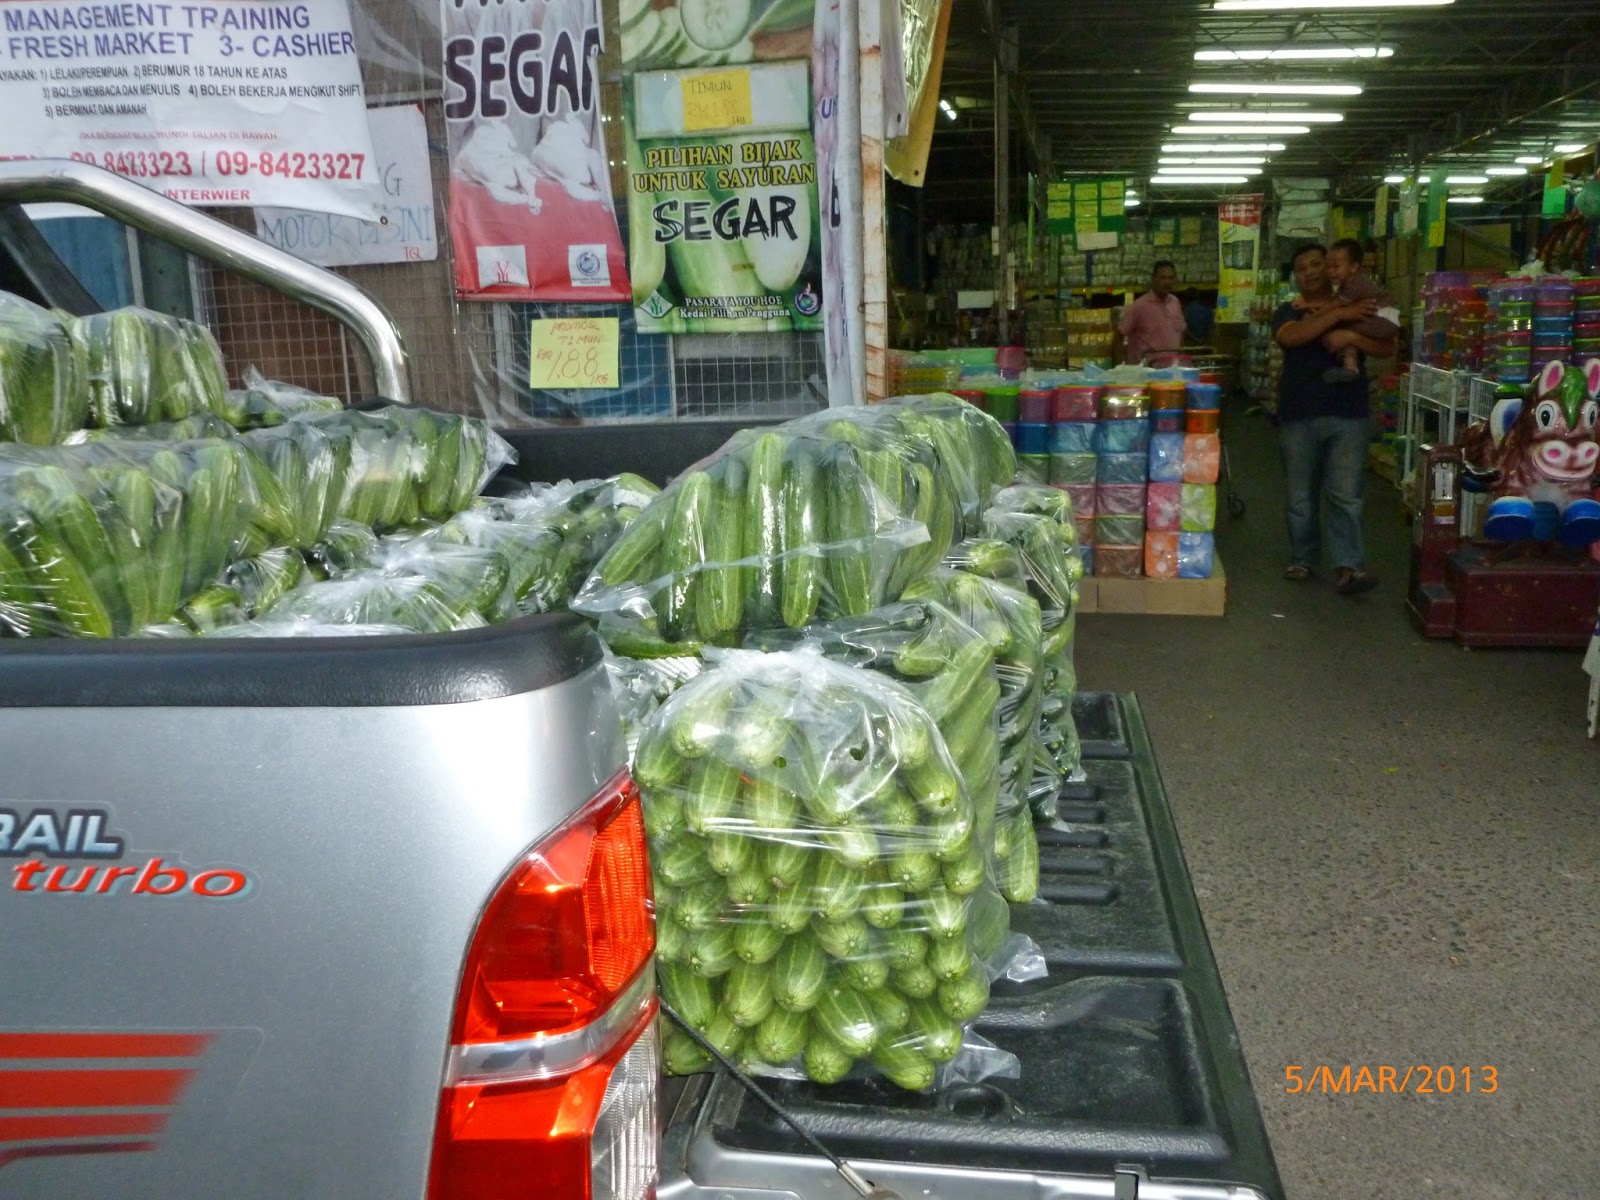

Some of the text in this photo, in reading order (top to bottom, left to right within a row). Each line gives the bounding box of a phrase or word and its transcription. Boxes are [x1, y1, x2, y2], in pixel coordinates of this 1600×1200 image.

[4, 4, 311, 32] MANAGEMENT TRAINING
[9, 34, 88, 59] FRESH
[94, 32, 193, 57] MARKET
[252, 31, 356, 58] CASHIER
[141, 64, 190, 77] BERUMUR
[194, 66, 205, 77] 18
[207, 65, 243, 78] TAHUN
[245, 67, 260, 79] KE
[262, 67, 288, 79] ATAS
[52, 86, 81, 98] BOLEH
[82, 85, 121, 97] MEMBACA
[122, 84, 139, 96] DAN
[140, 84, 180, 96] MENULIS
[189, 84, 199, 98] 4)
[200, 84, 236, 97] BOLEH
[238, 86, 287, 97] BEKERJA
[289, 85, 336, 97] MENGIKUT
[338, 84, 361, 97] SHIFT
[687, 80, 732, 94] TIMUN
[55, 104, 97, 116] BERMINAT
[98, 104, 114, 115] DAN
[242, 131, 278, 140] BAWAH
[647, 139, 802, 169] PILIHAN BIJAK
[216, 151, 365, 180] 09-8423327
[633, 162, 816, 193] UNTUK SAYURAN
[653, 195, 798, 243] SEGAR
[685, 295, 783, 307] PASARAYA YOU HOE
[680, 308, 791, 320] Kedai Pilihan Pengguna
[13, 857, 252, 897] turbo
